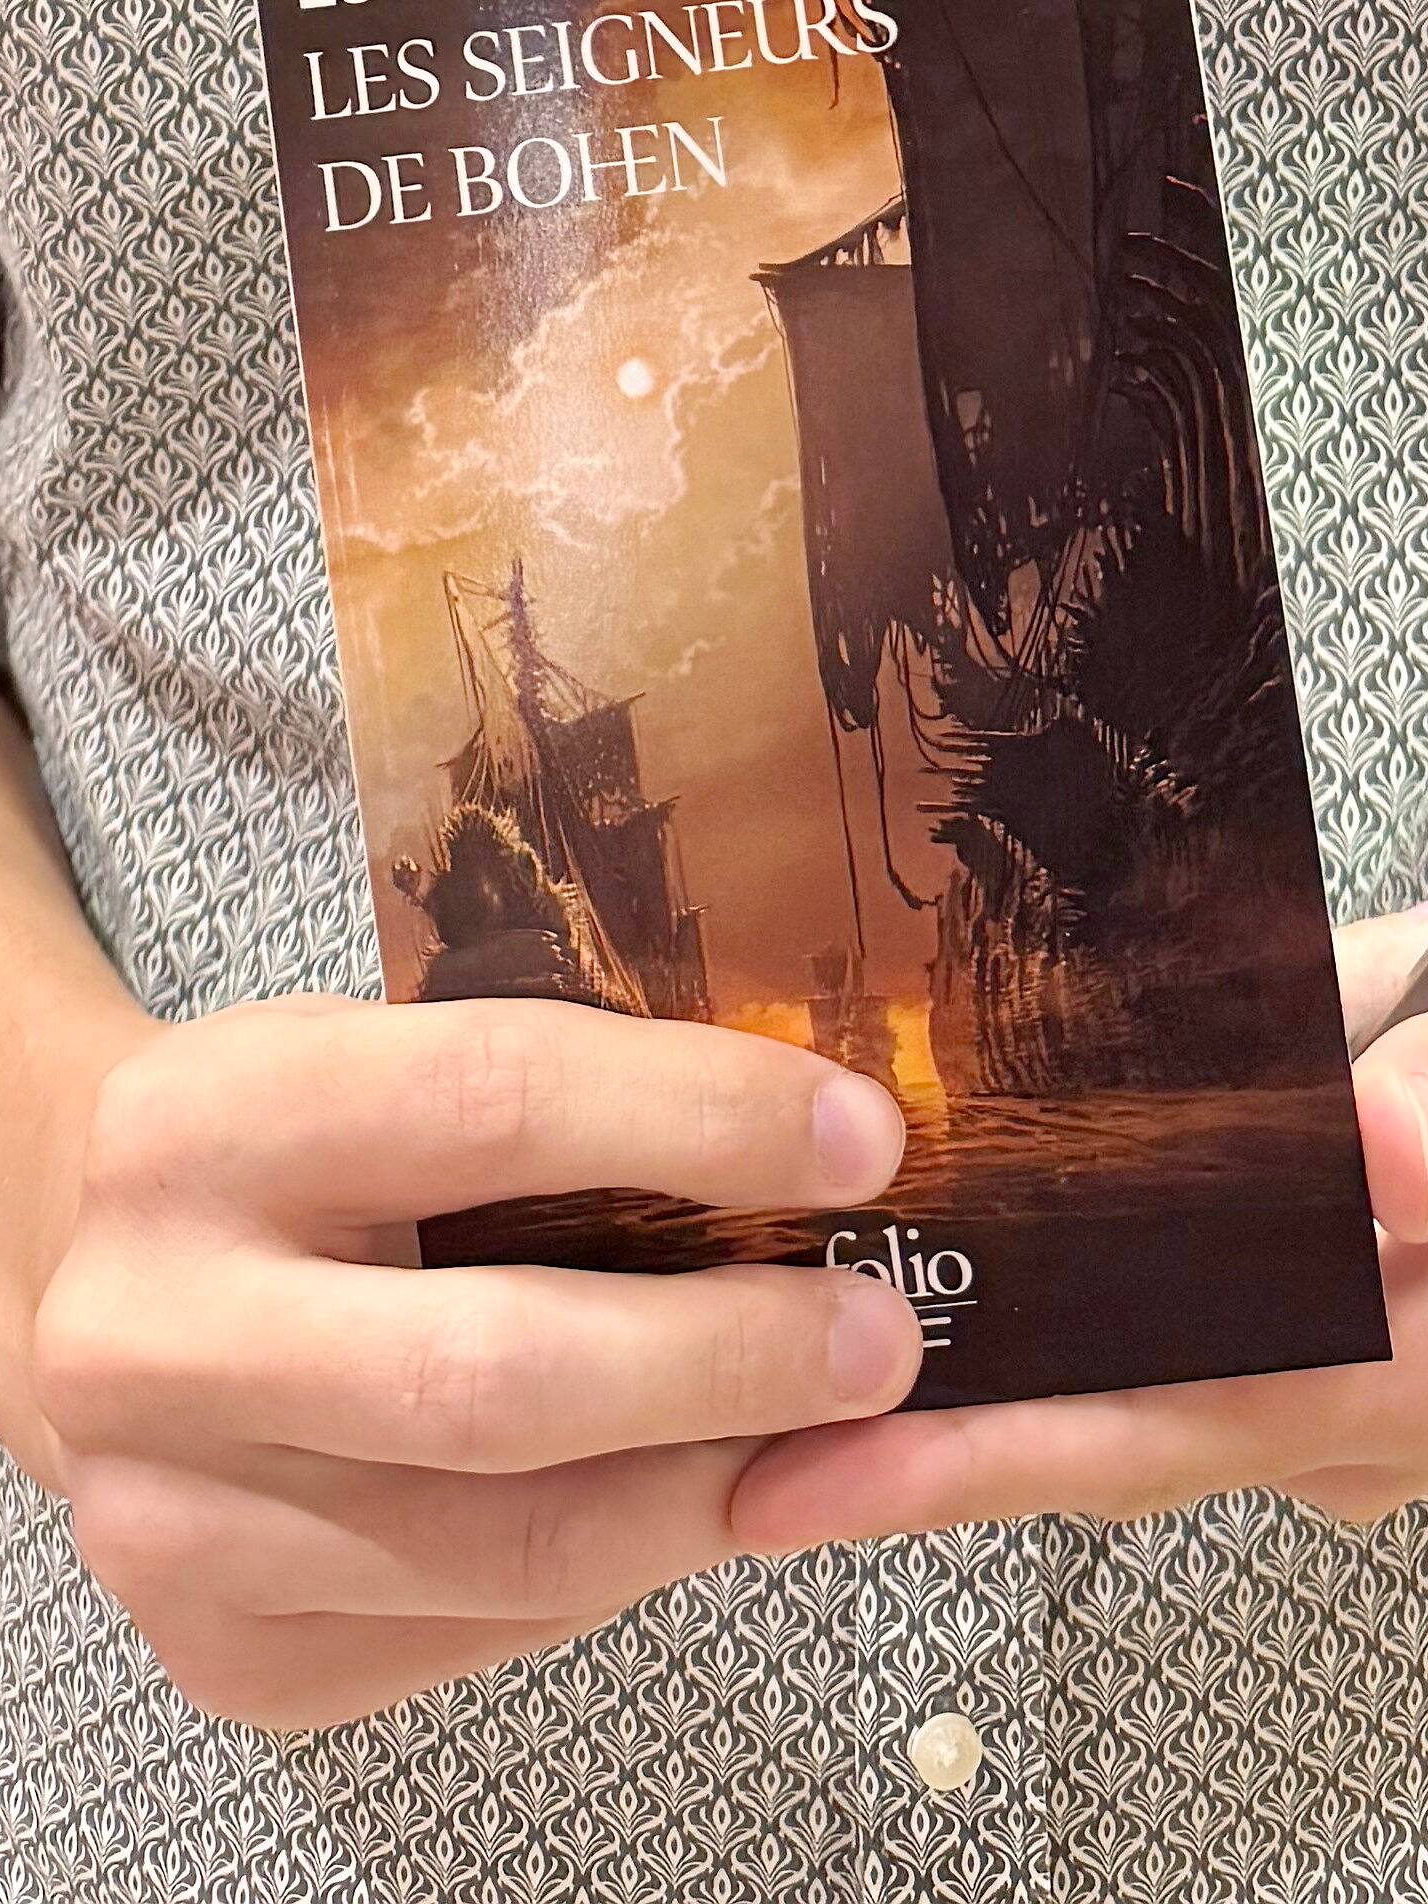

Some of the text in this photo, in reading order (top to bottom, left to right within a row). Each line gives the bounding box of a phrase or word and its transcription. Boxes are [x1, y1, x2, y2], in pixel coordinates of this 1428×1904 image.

[302, 36, 446, 123] LES
[315, 114, 732, 234] DE BOHEN
